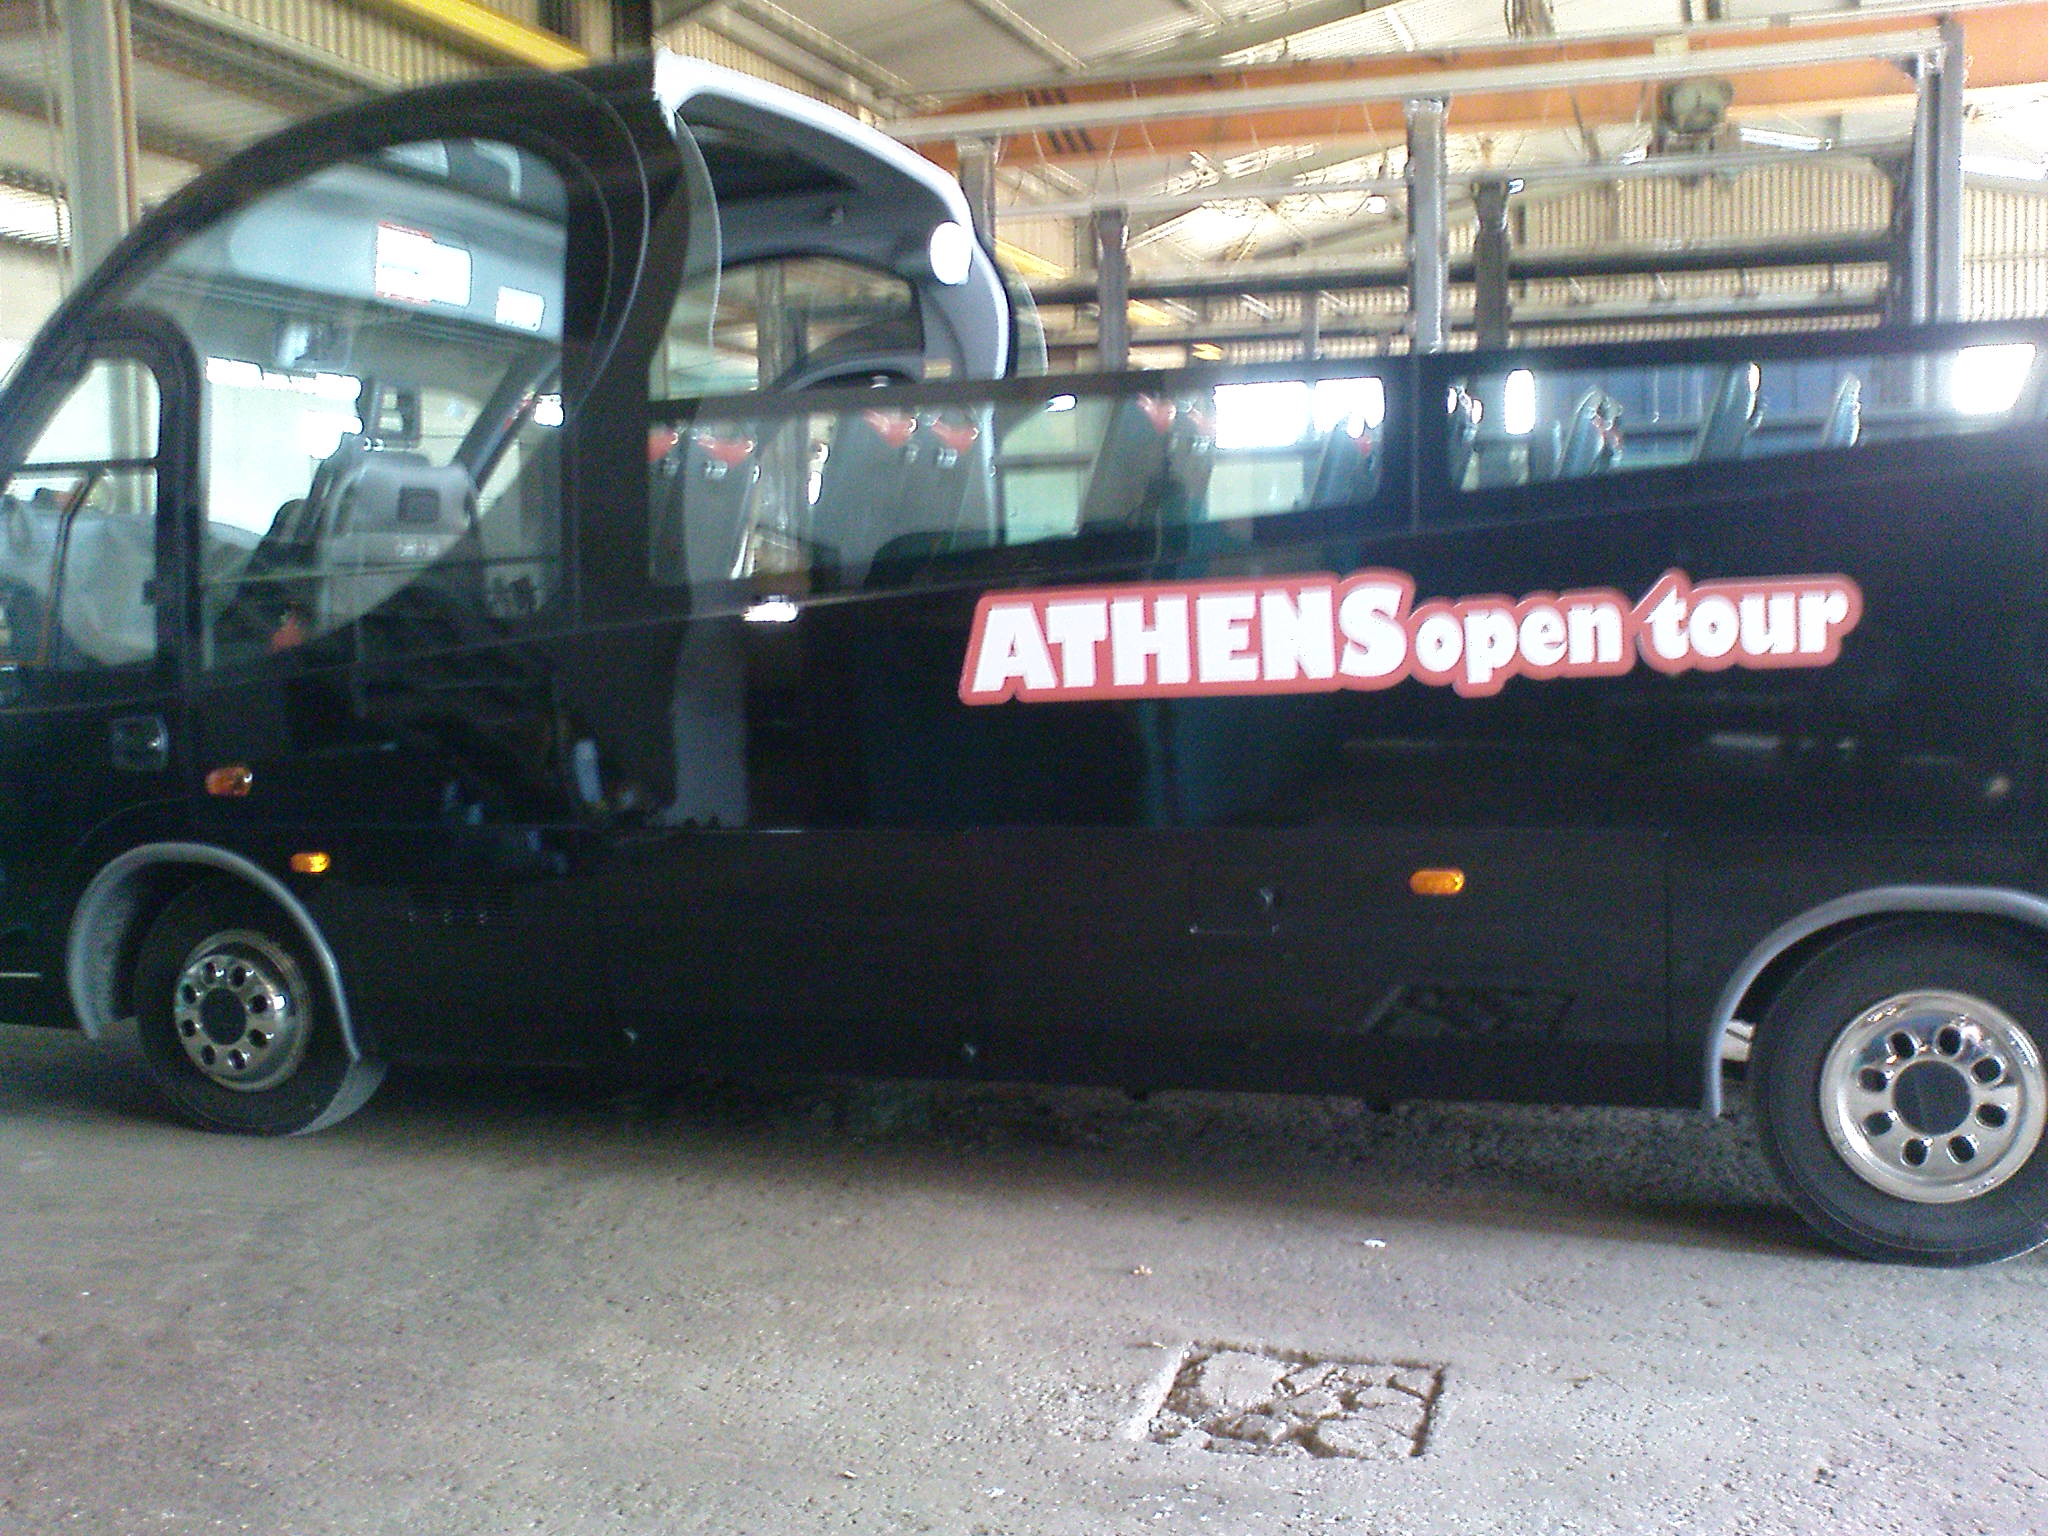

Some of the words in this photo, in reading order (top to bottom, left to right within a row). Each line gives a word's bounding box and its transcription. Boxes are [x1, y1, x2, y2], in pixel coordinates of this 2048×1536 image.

[970, 581, 1408, 693] ATHENS
[1414, 603, 1624, 685] open
[1641, 583, 1850, 661] tour
